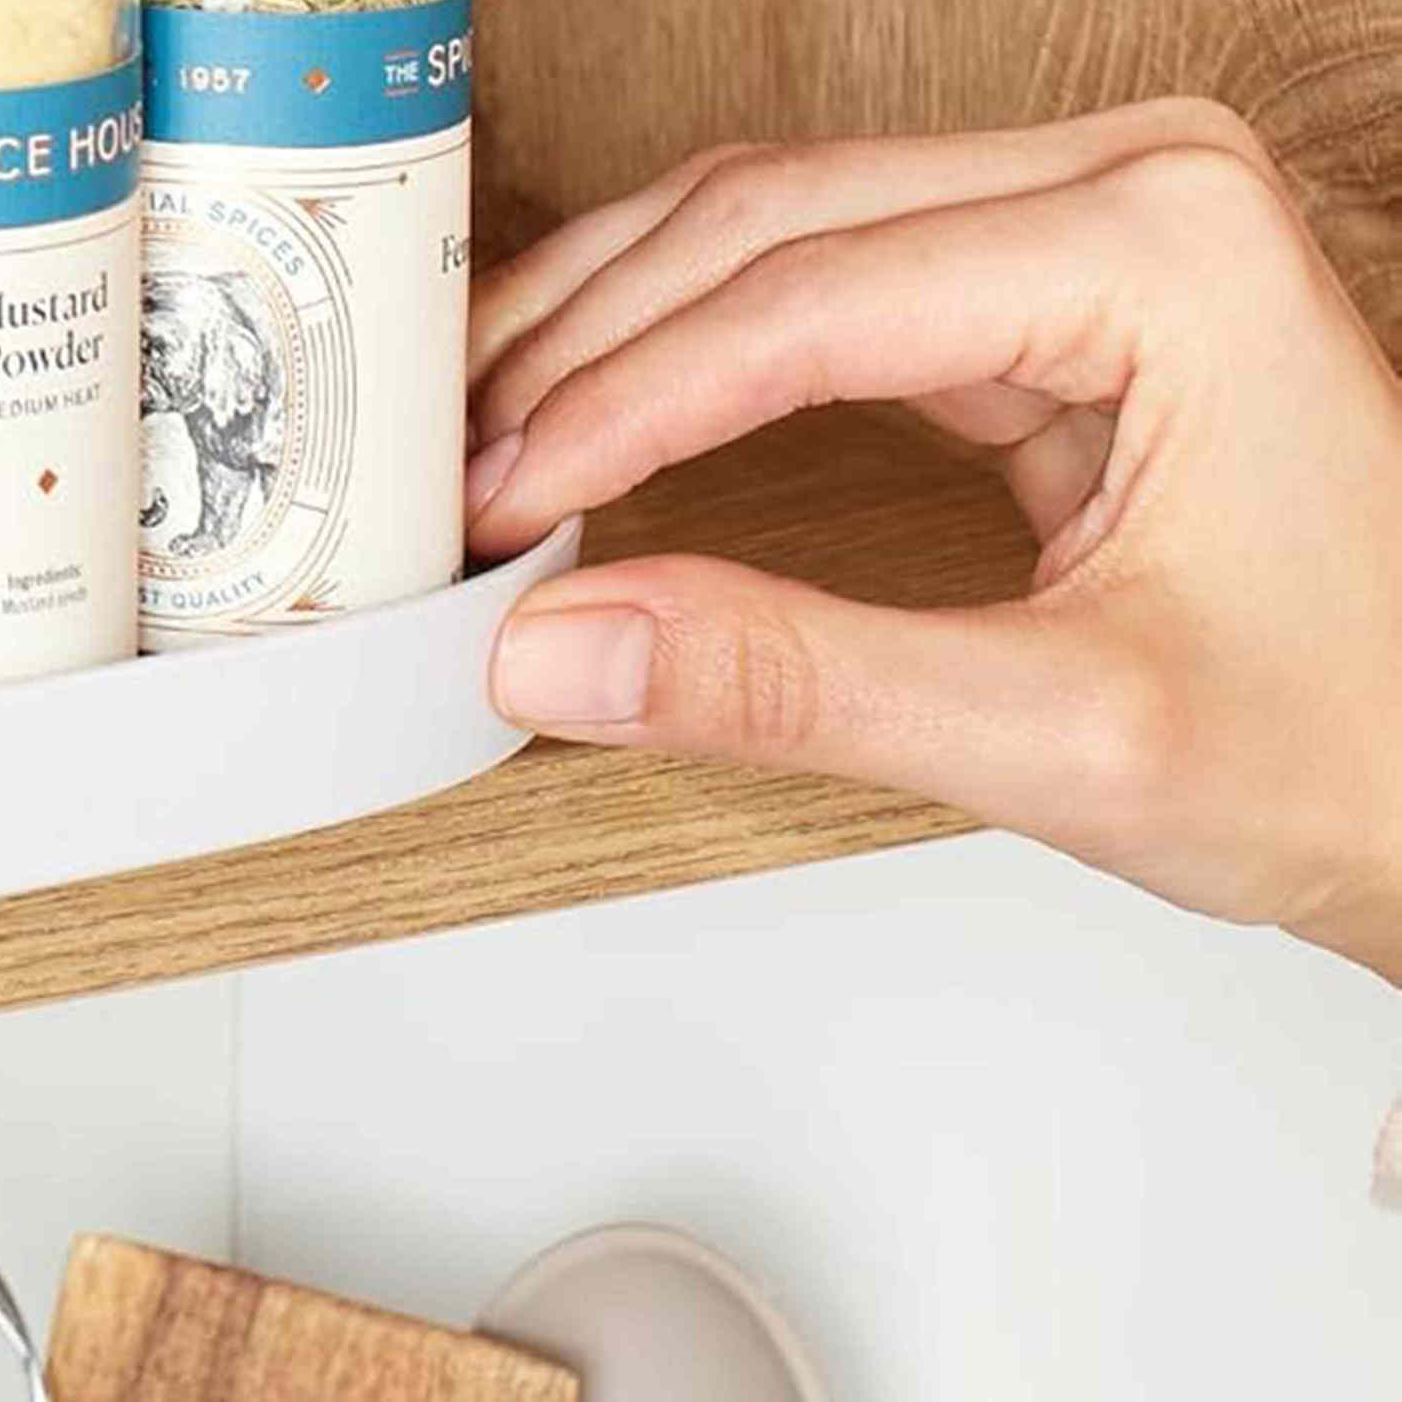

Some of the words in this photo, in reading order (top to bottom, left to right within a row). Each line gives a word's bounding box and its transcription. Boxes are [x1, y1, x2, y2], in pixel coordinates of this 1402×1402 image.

[181, 66, 251, 93] 1957
[385, 60, 420, 85] THE
[206, 199, 306, 279] SPICES
[63, 383, 101, 408] HEAT
[171, 570, 264, 610] QUALITY
